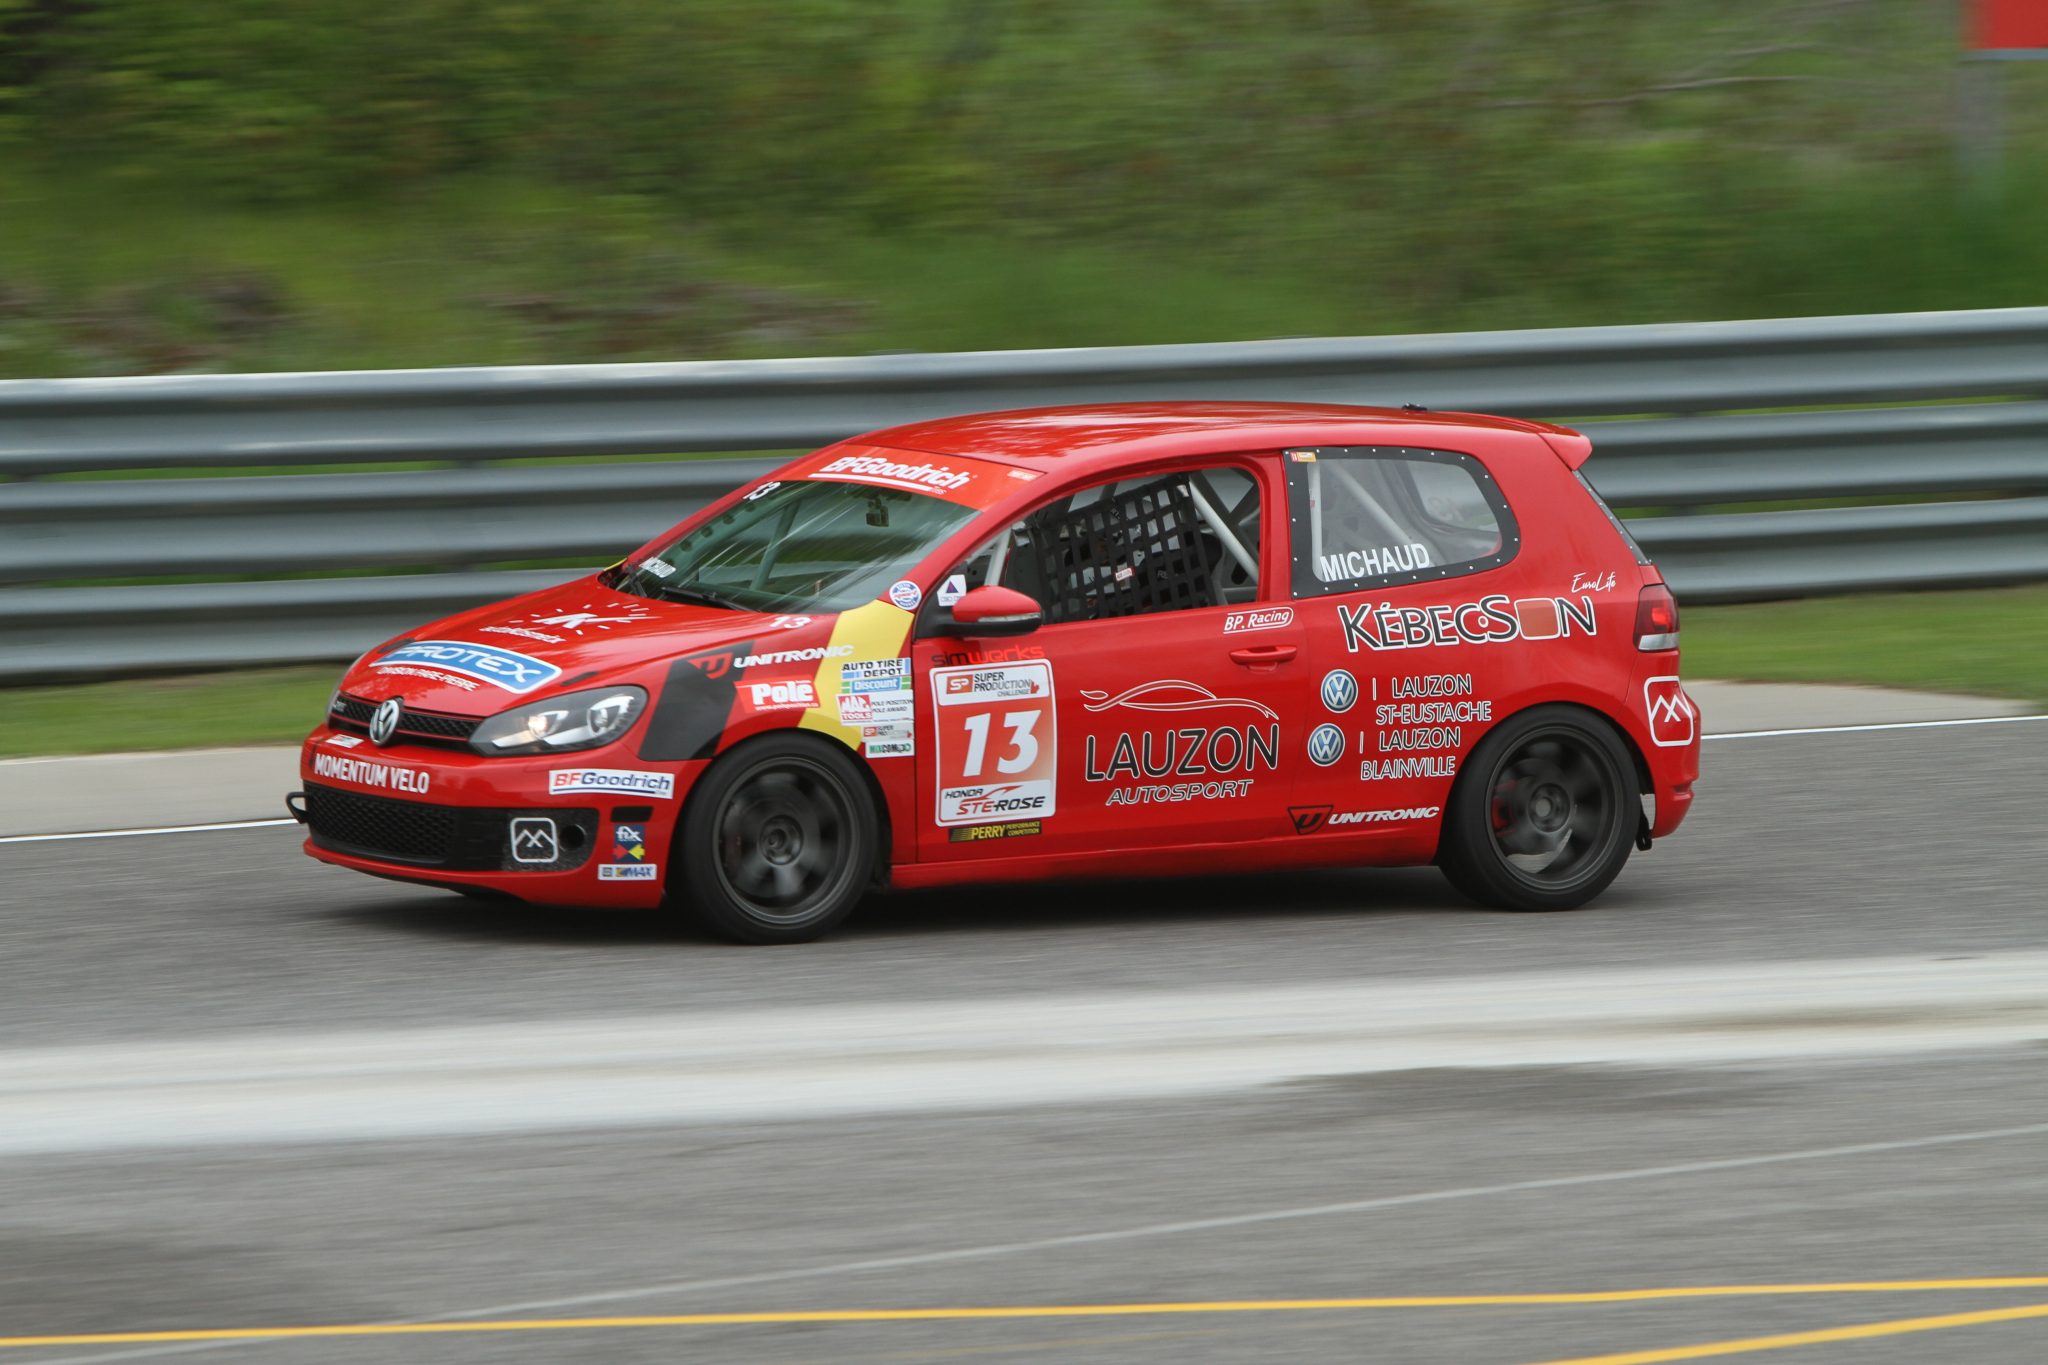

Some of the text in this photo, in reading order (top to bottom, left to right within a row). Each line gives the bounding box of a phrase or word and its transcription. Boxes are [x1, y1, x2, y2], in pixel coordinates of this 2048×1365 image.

[819, 456, 970, 489] BFGoodrich
[1320, 543, 1431, 582] MICHAUD
[1571, 571, 1617, 593] EuroLite
[769, 615, 811, 629] 13
[1247, 609, 1291, 628] Racing
[386, 645, 542, 684] PROTEX
[733, 644, 856, 669] UNITRONIC
[842, 659, 903, 671] AUTO TIRE
[932, 645, 1045, 668] simwerks
[863, 667, 903, 677] DEPOT
[974, 671, 1005, 683] SUPER
[750, 680, 814, 705] Pole
[854, 678, 898, 691] Discount
[974, 679, 1032, 692] PRODUCTION
[997, 688, 1031, 697] CHALLENGE
[1391, 673, 1472, 700] LAUZON
[841, 712, 873, 720] TOOLS
[1375, 700, 1492, 725] ST-EUSTACHE
[962, 709, 1042, 777] 13
[1378, 726, 1462, 752] LAUZON
[1085, 723, 1280, 781] LAUZON
[314, 753, 430, 795] MOMENTUM VELO
[1360, 755, 1456, 781] BLAINVILLE
[554, 772, 671, 790] BFGoodrich
[944, 787, 984, 800] HONDA
[1105, 779, 1254, 806] AUTOSPORT
[956, 795, 1047, 816] STE-ROSE
[1328, 805, 1440, 825] UNITRONIC
[971, 824, 1006, 840] PERRY
